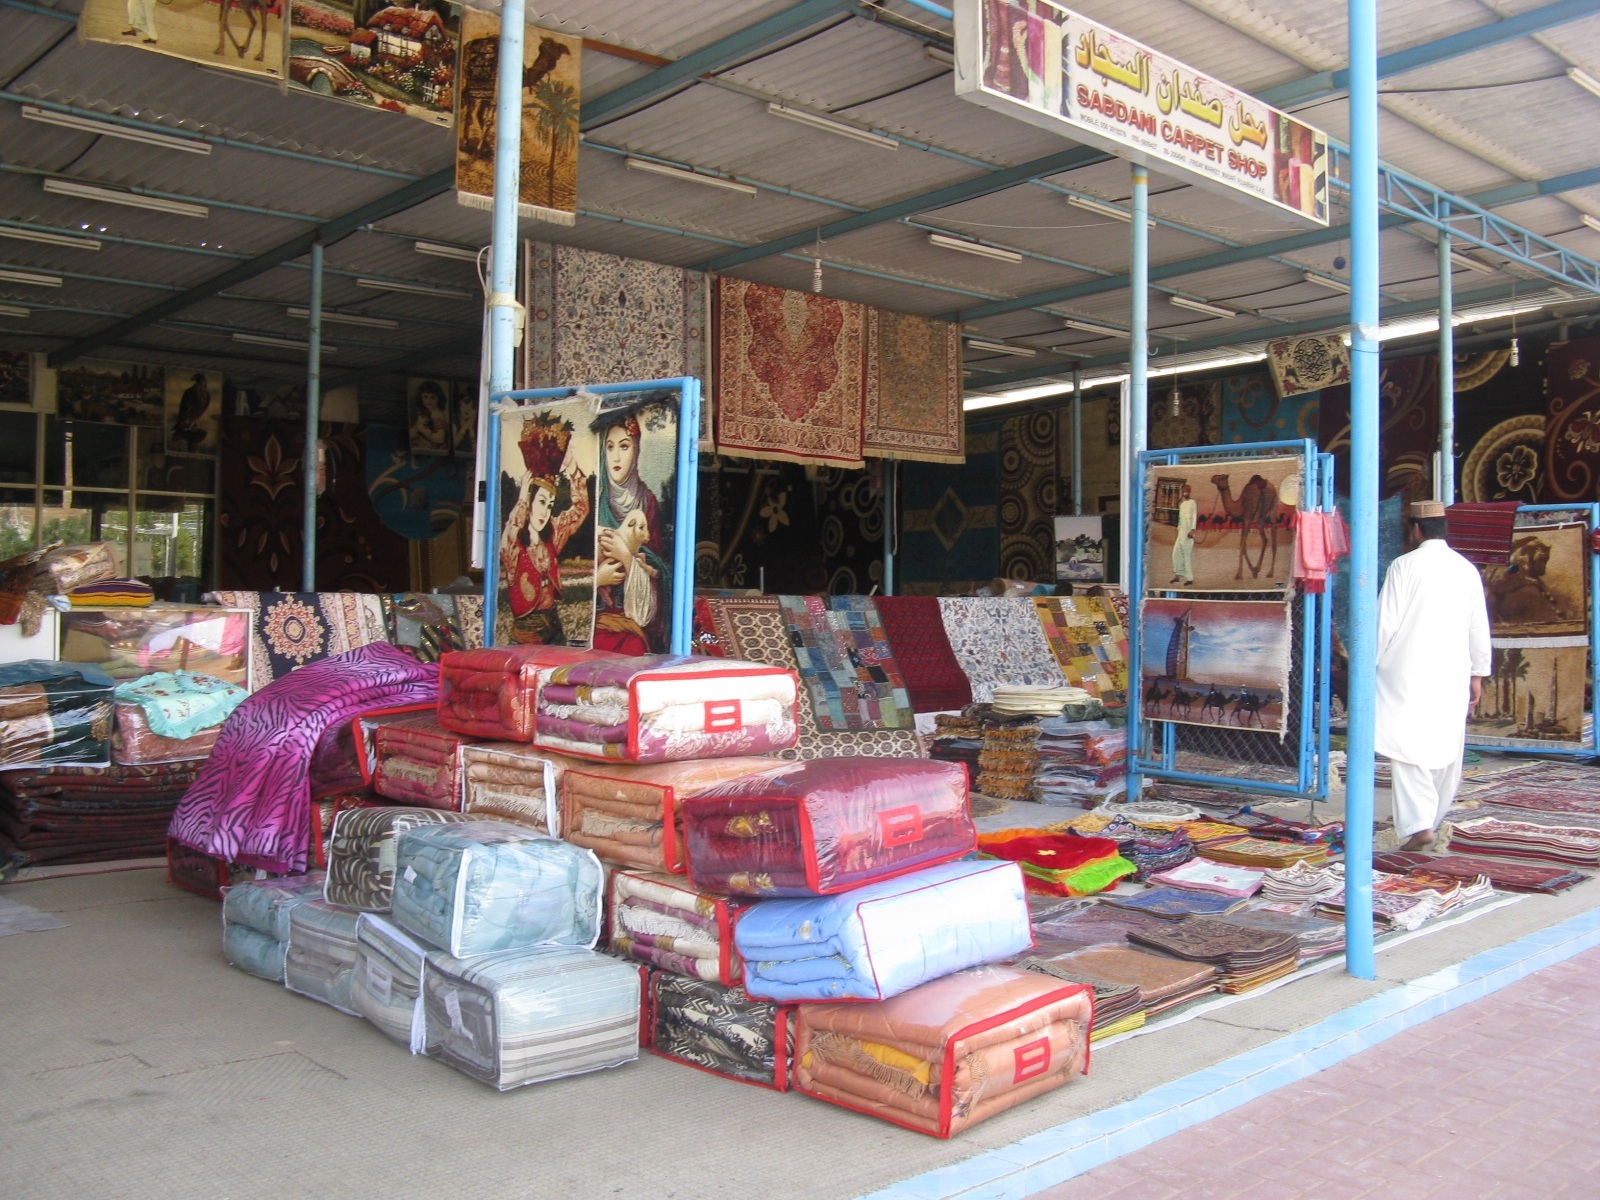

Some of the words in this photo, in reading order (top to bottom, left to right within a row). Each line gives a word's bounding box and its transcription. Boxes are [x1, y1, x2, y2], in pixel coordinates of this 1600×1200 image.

[1075, 29, 1150, 97] السجاد
[1076, 83, 1157, 136] SABDANI
[1161, 120, 1224, 164] CARPET
[1227, 148, 1267, 181] SHOP
[1228, 100, 1268, 150] محل
